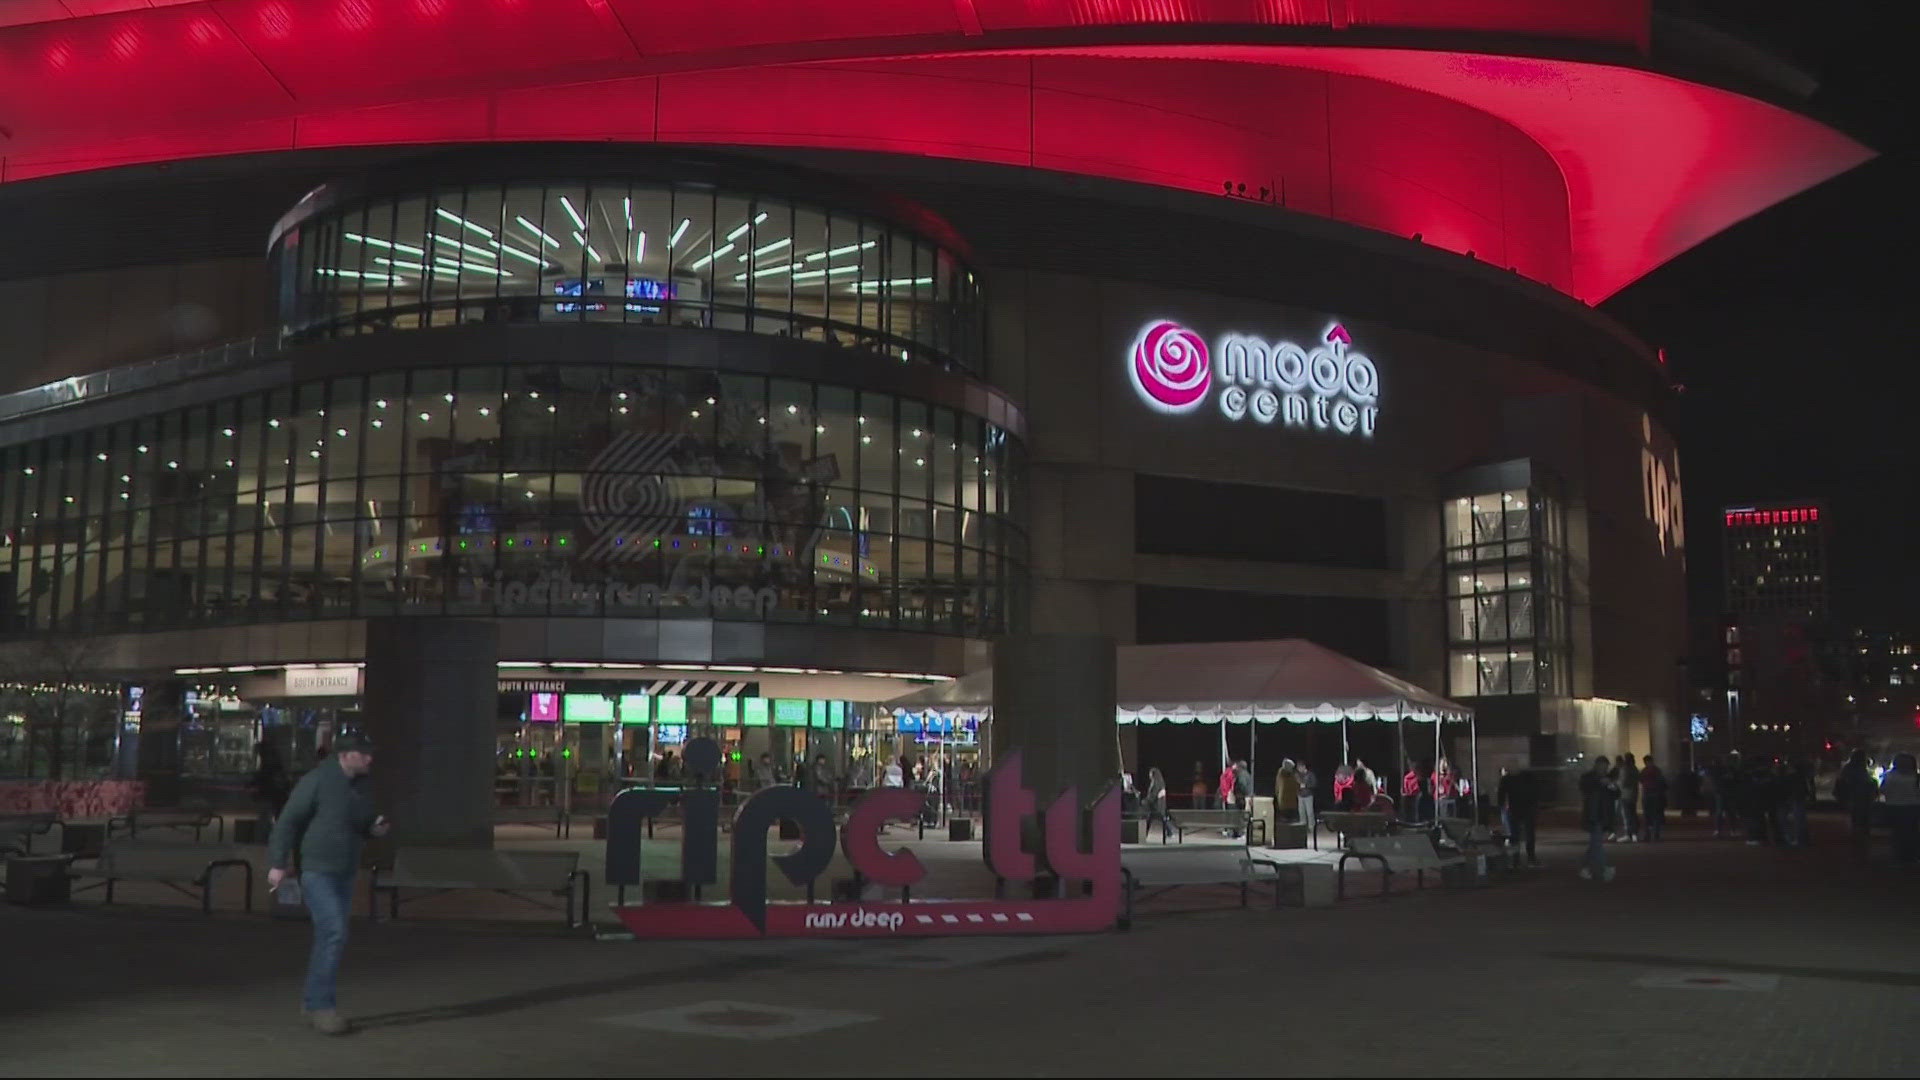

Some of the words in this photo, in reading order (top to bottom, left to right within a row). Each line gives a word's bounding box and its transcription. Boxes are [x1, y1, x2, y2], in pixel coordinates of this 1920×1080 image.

[1223, 323, 1380, 400] moda
[1219, 386, 1380, 438] center
[294, 676, 315, 689] SOUTH
[316, 675, 349, 688] ENTRANCE
[524, 680, 566, 692] ENTRANCE
[805, 911, 848, 929] runs
[850, 905, 904, 933] deep
